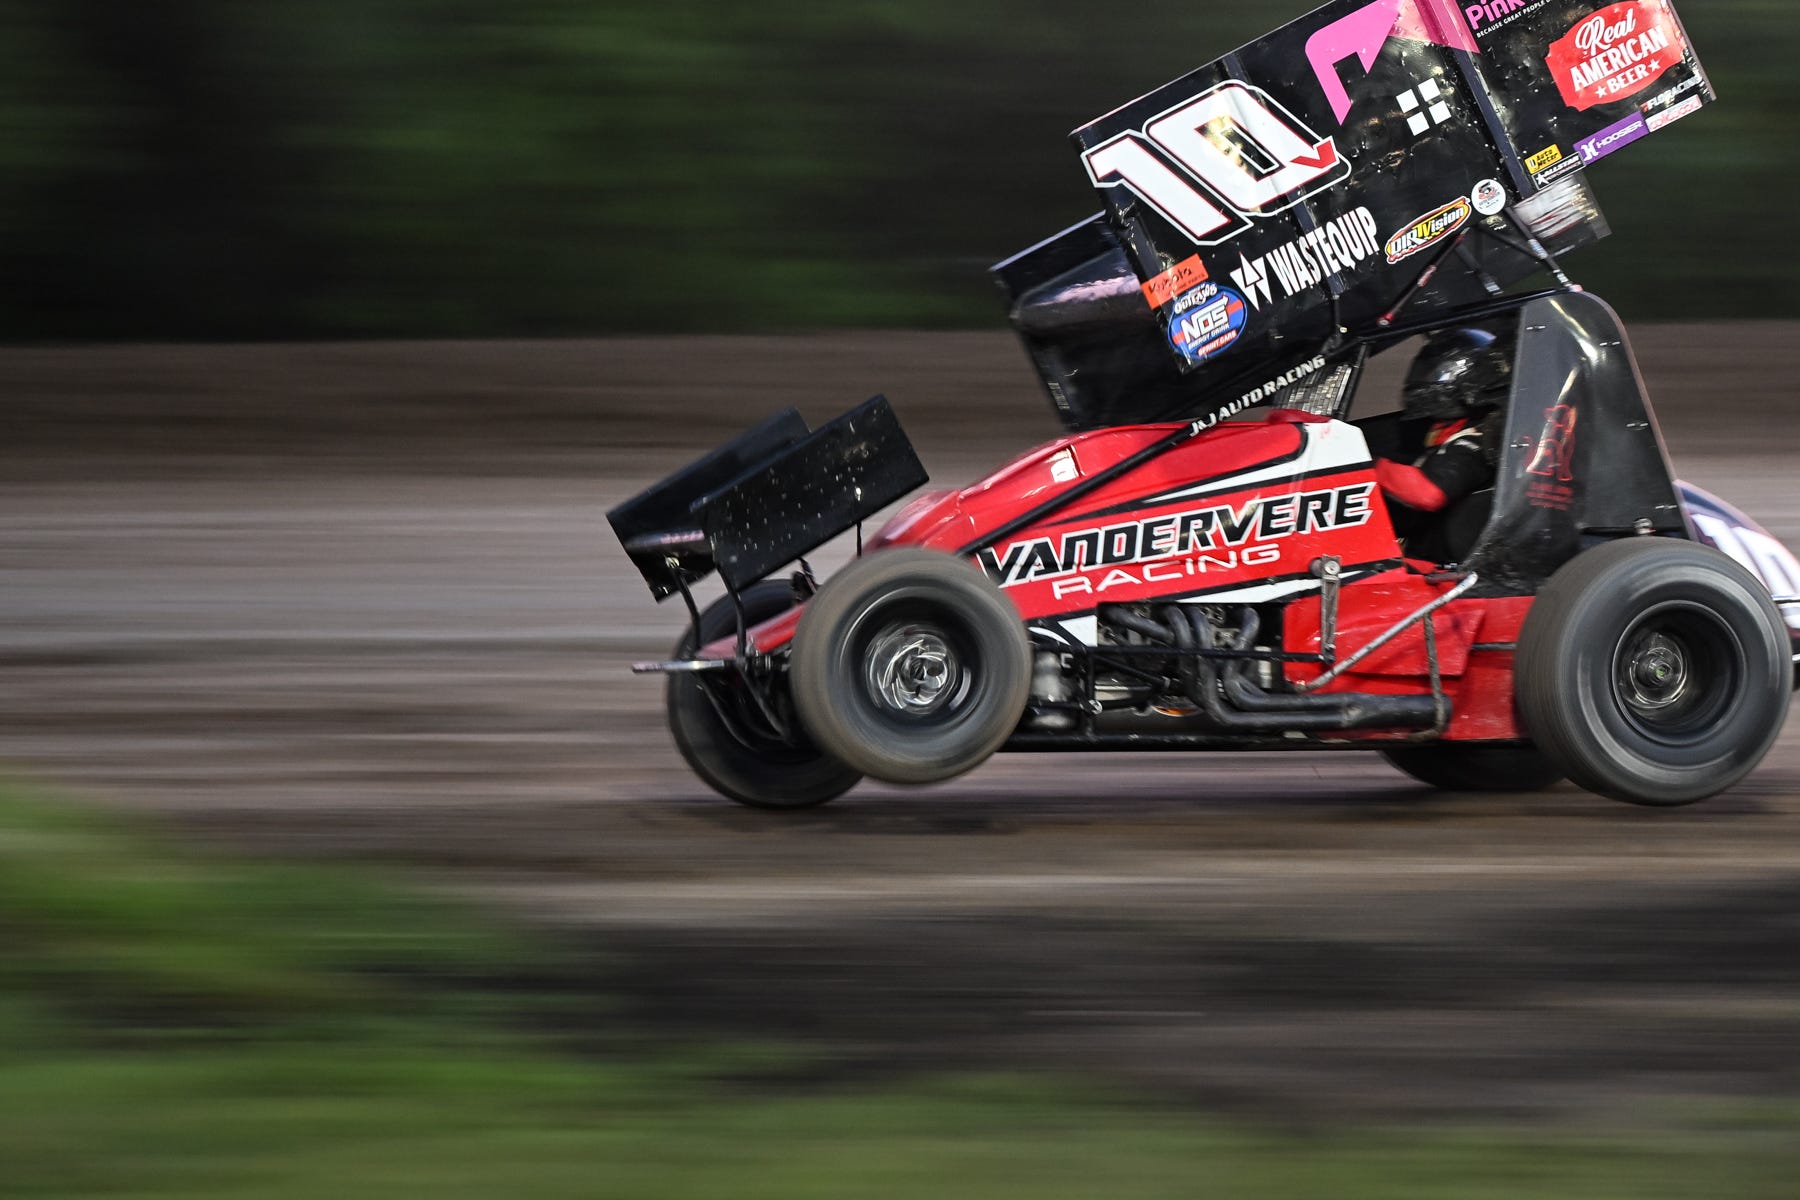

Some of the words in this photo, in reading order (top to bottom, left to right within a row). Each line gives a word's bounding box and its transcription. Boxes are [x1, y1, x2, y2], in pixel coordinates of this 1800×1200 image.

[1476, 22, 1504, 39] BECAUSE
[1503, 11, 1522, 26] GREAT
[1522, 0, 1545, 16] PEOPLE
[1574, 7, 1637, 57] Real
[1569, 24, 1670, 93] AMERICAN
[1606, 63, 1650, 94] BEER
[1081, 79, 1351, 245] 10
[1595, 120, 1644, 150] HOOSIER
[1265, 206, 1380, 297] WASTEQUIP
[1148, 266, 1192, 294] Kubota
[1180, 294, 1230, 345] NOS
[1218, 388, 1264, 422] AUTO
[1262, 354, 1326, 397] RACING
[975, 481, 1378, 590] VANDERVERE
[1052, 542, 1281, 601] RACING
